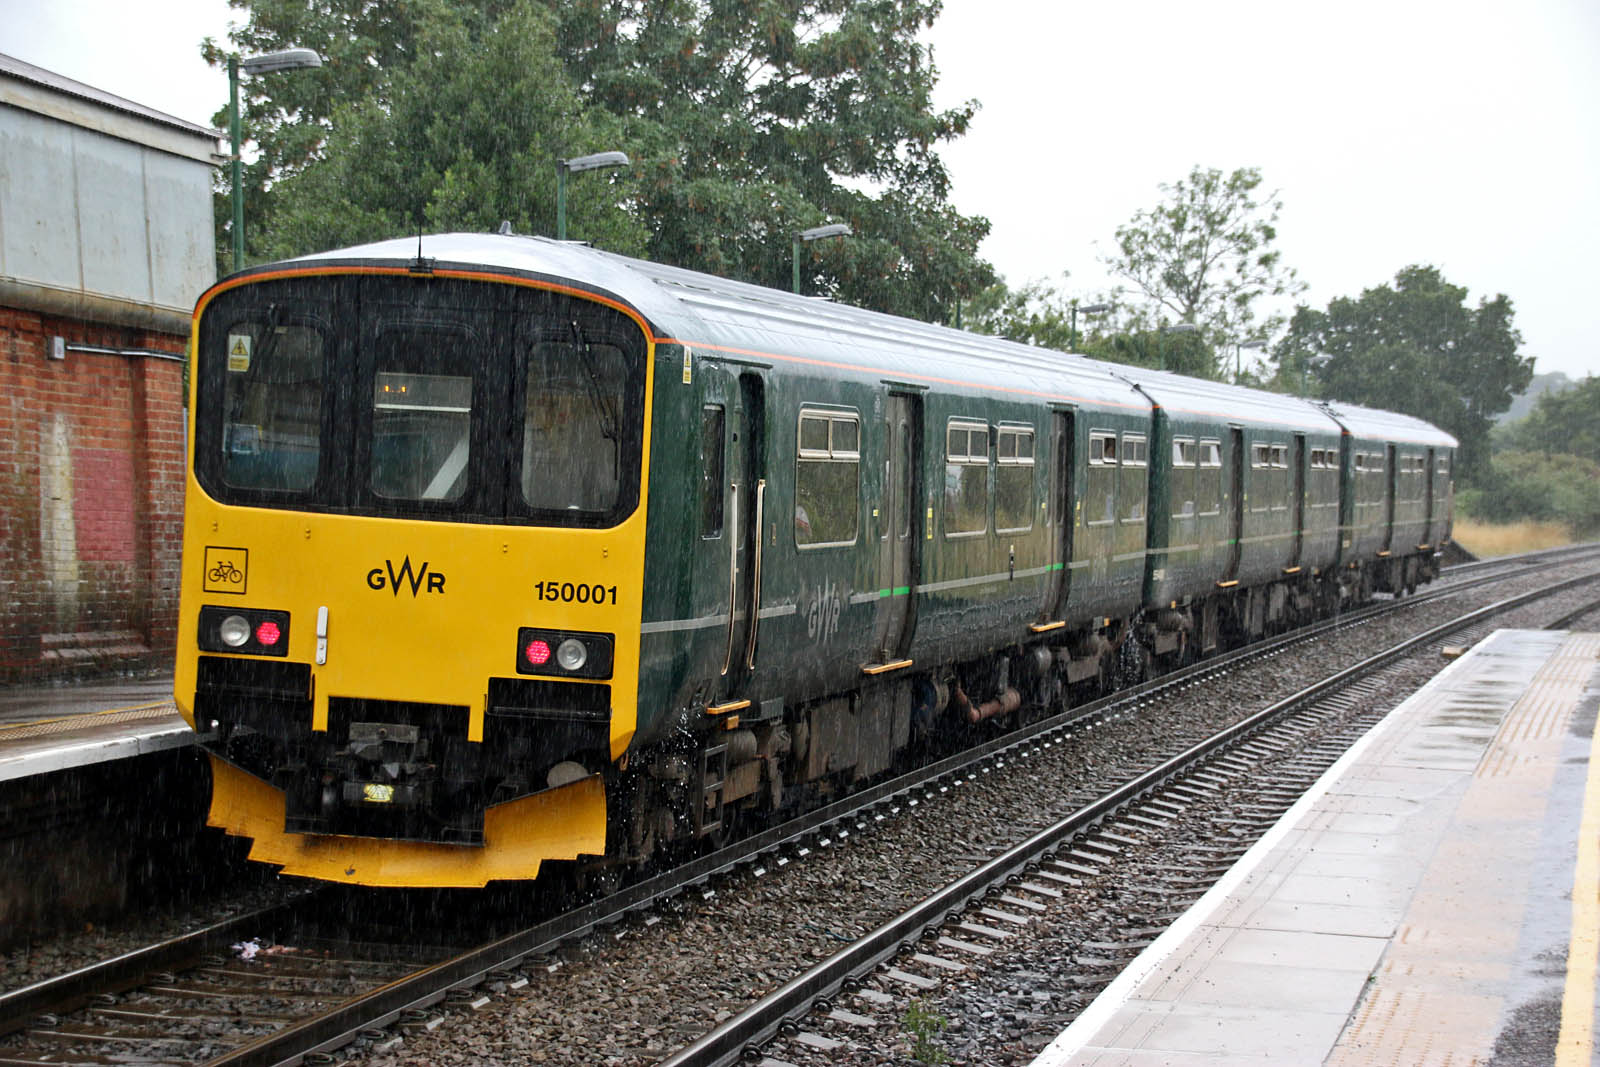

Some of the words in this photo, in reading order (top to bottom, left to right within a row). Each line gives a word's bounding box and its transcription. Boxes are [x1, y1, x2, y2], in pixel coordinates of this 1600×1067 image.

[367, 554, 446, 599] GWR
[534, 581, 617, 605] 150001
[808, 577, 840, 645] GWR
